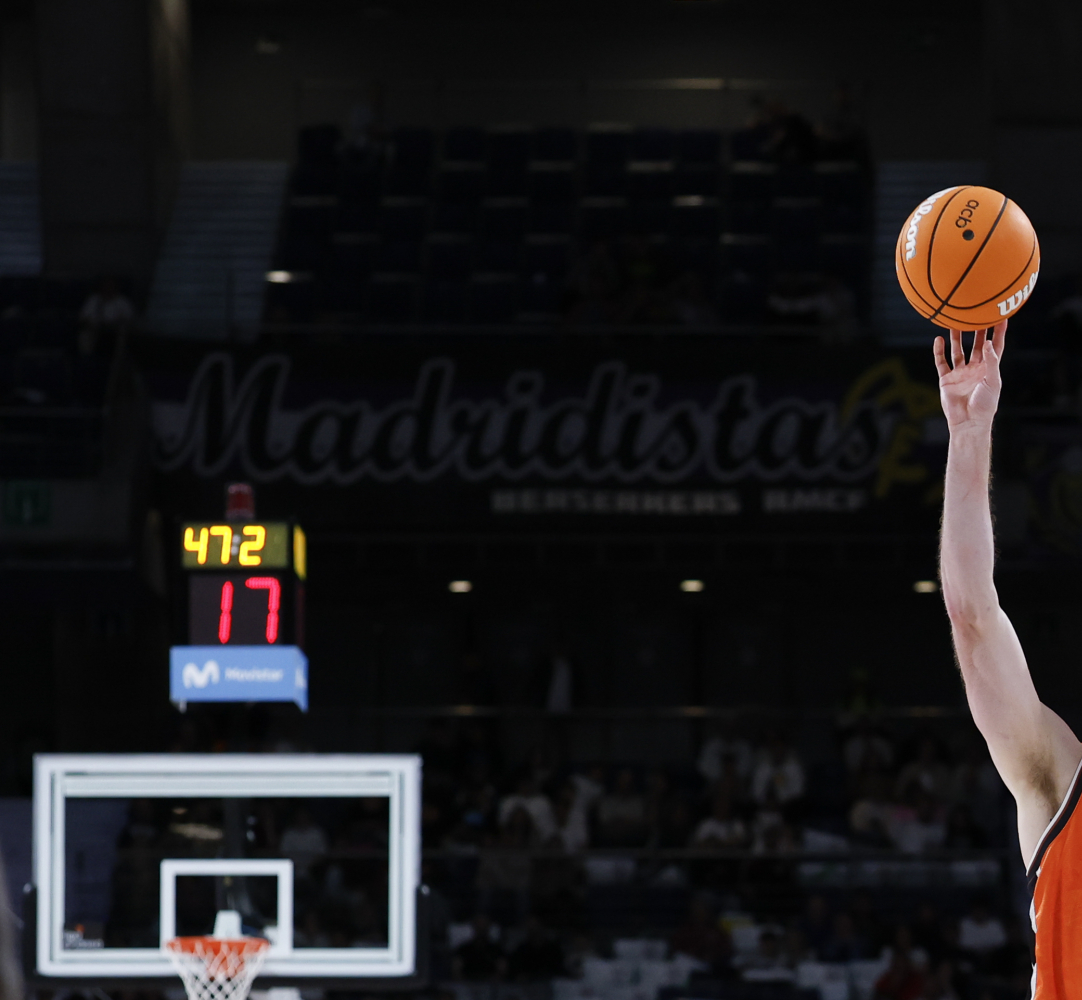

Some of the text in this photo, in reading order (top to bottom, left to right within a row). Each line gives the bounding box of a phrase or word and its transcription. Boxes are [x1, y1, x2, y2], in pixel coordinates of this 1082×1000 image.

[955, 200, 980, 229] acb
[150, 351, 883, 484] Madridistas
[218, 577, 281, 644] 17
